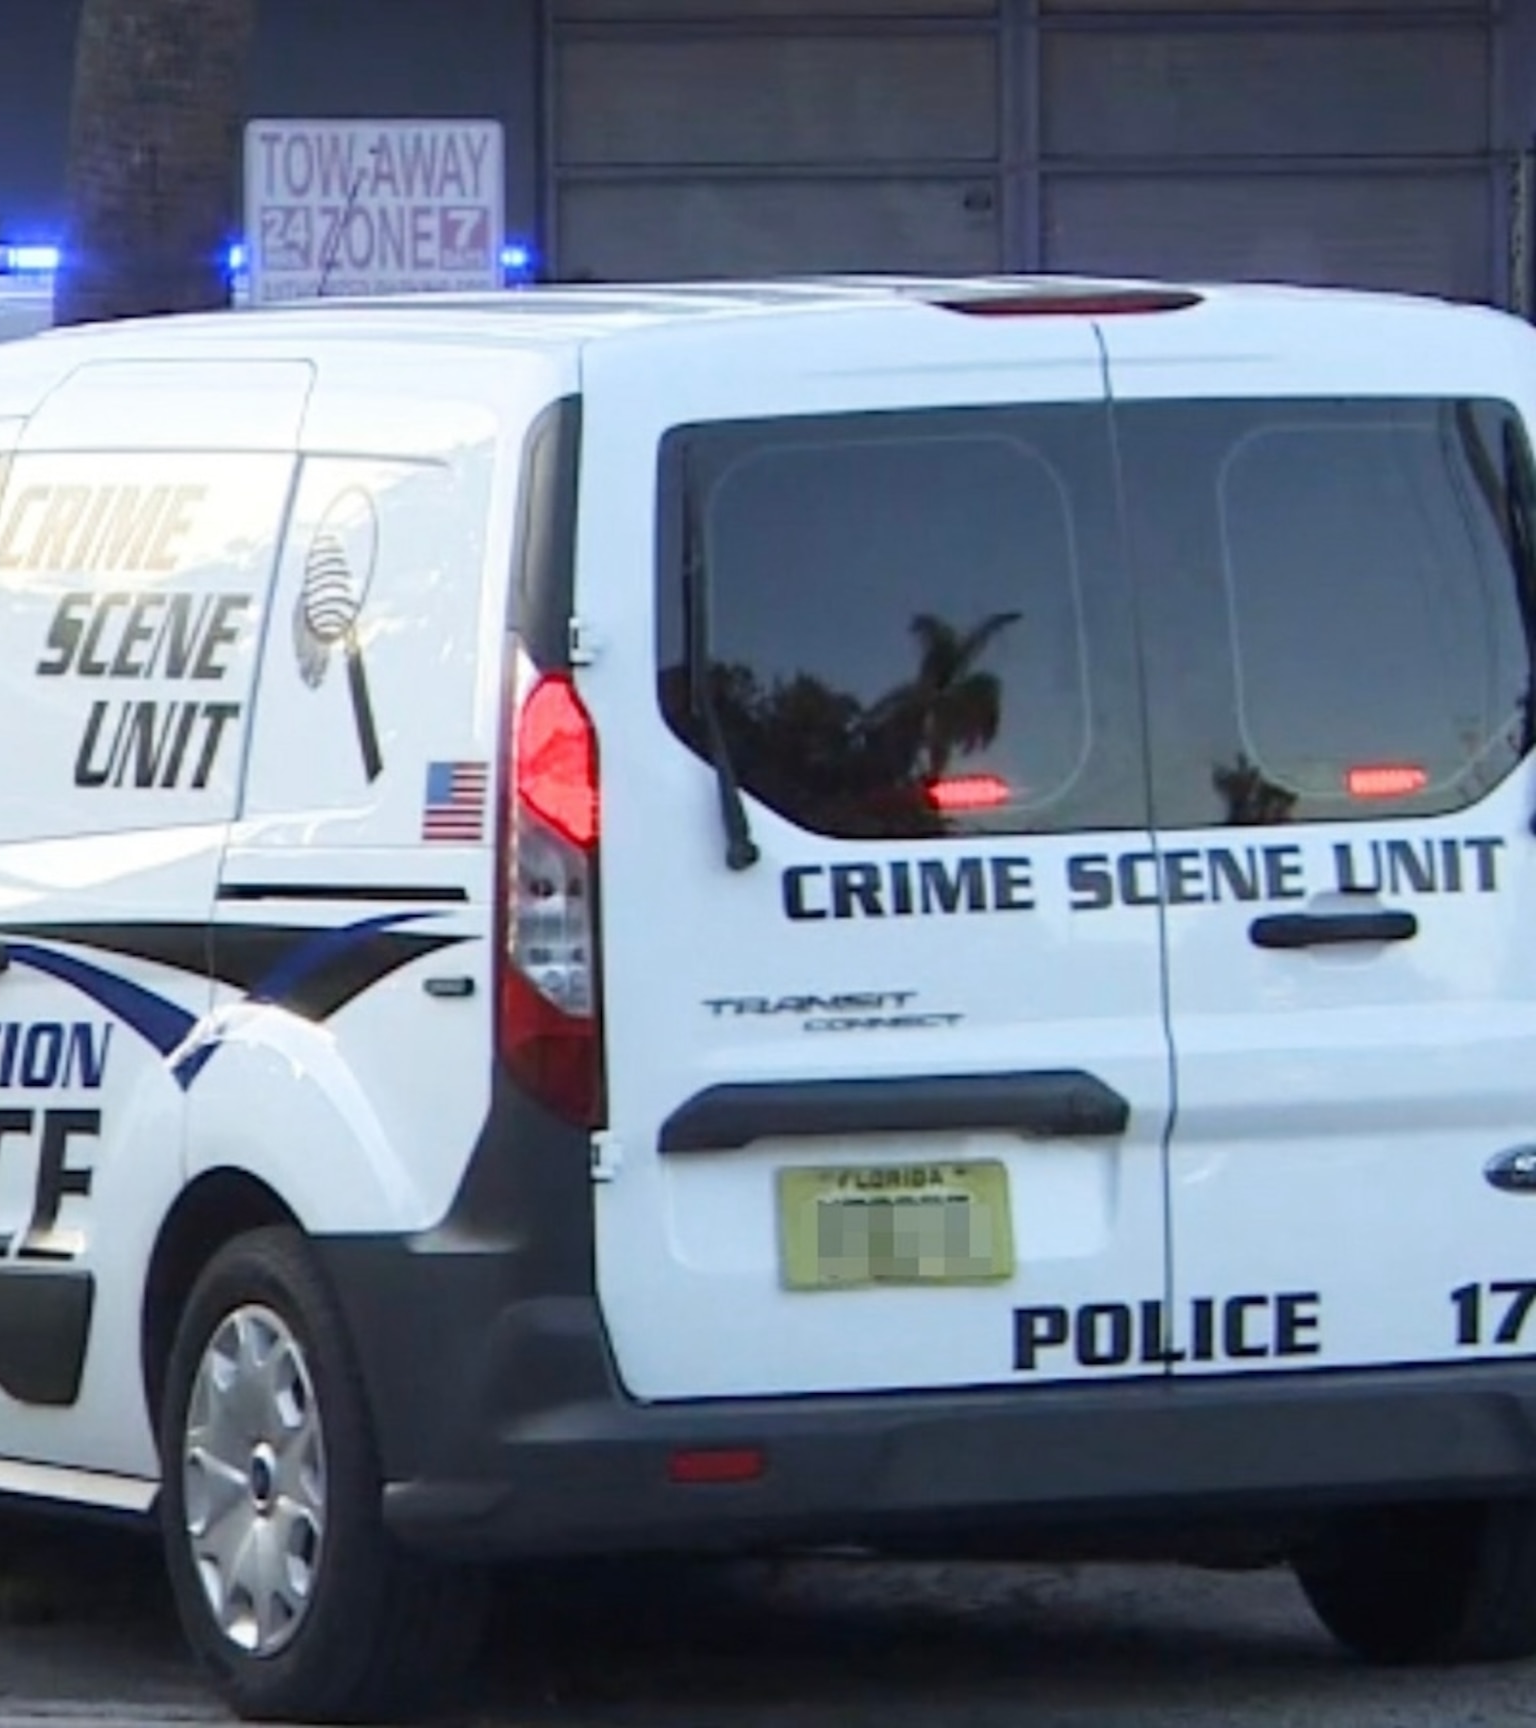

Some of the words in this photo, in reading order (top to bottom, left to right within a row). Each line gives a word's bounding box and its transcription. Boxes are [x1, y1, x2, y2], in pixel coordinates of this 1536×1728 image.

[317, 205, 434, 269] ZONE
[447, 208, 482, 248] 7
[35, 593, 253, 679] SCENE
[74, 699, 241, 788] UNIT
[782, 857, 1033, 920] CRIME
[1067, 845, 1304, 910] SCENE
[1333, 837, 1505, 895] UNIT
[699, 991, 917, 1016] TRANSIT
[802, 1013, 964, 1031] CONNECT
[838, 1167, 944, 1188] FLORIDA
[1013, 1292, 1321, 1370] POLICE
[1451, 1282, 1536, 1345] 17
